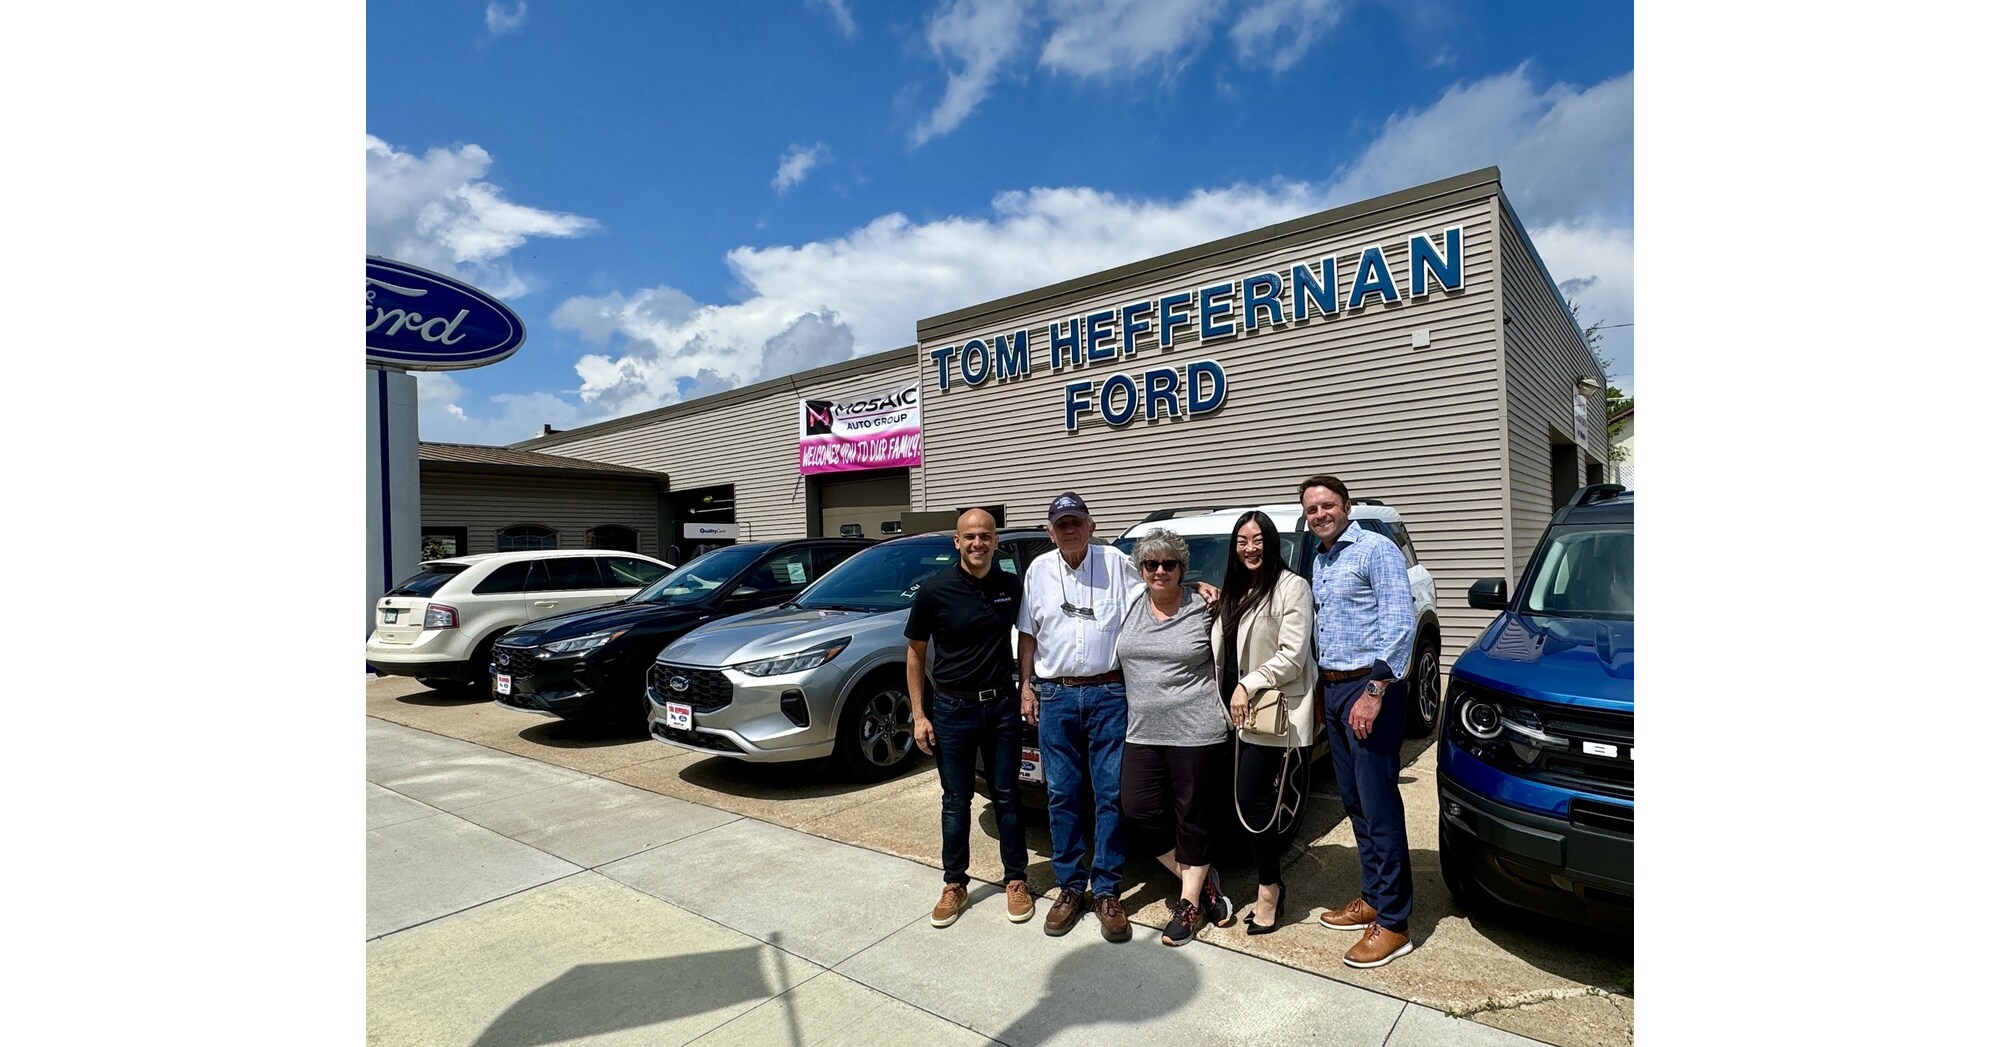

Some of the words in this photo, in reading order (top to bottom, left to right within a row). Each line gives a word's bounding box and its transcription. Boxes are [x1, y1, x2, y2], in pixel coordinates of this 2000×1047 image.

[366, 277, 470, 345] ord
[930, 328, 1030, 390] TOM
[1049, 224, 1464, 370] HEFFERNAN
[835, 388, 917, 416] MOSAIC
[1065, 359, 1227, 431] FORD
[847, 419, 872, 430] AUTO
[873, 413, 907, 427] GROUP
[802, 442, 840, 467] WELCOMES
[840, 442, 857, 464] YOU
[857, 441, 868, 463] TO
[869, 439, 888, 461] OUR
[888, 433, 921, 460] FAMILY!
